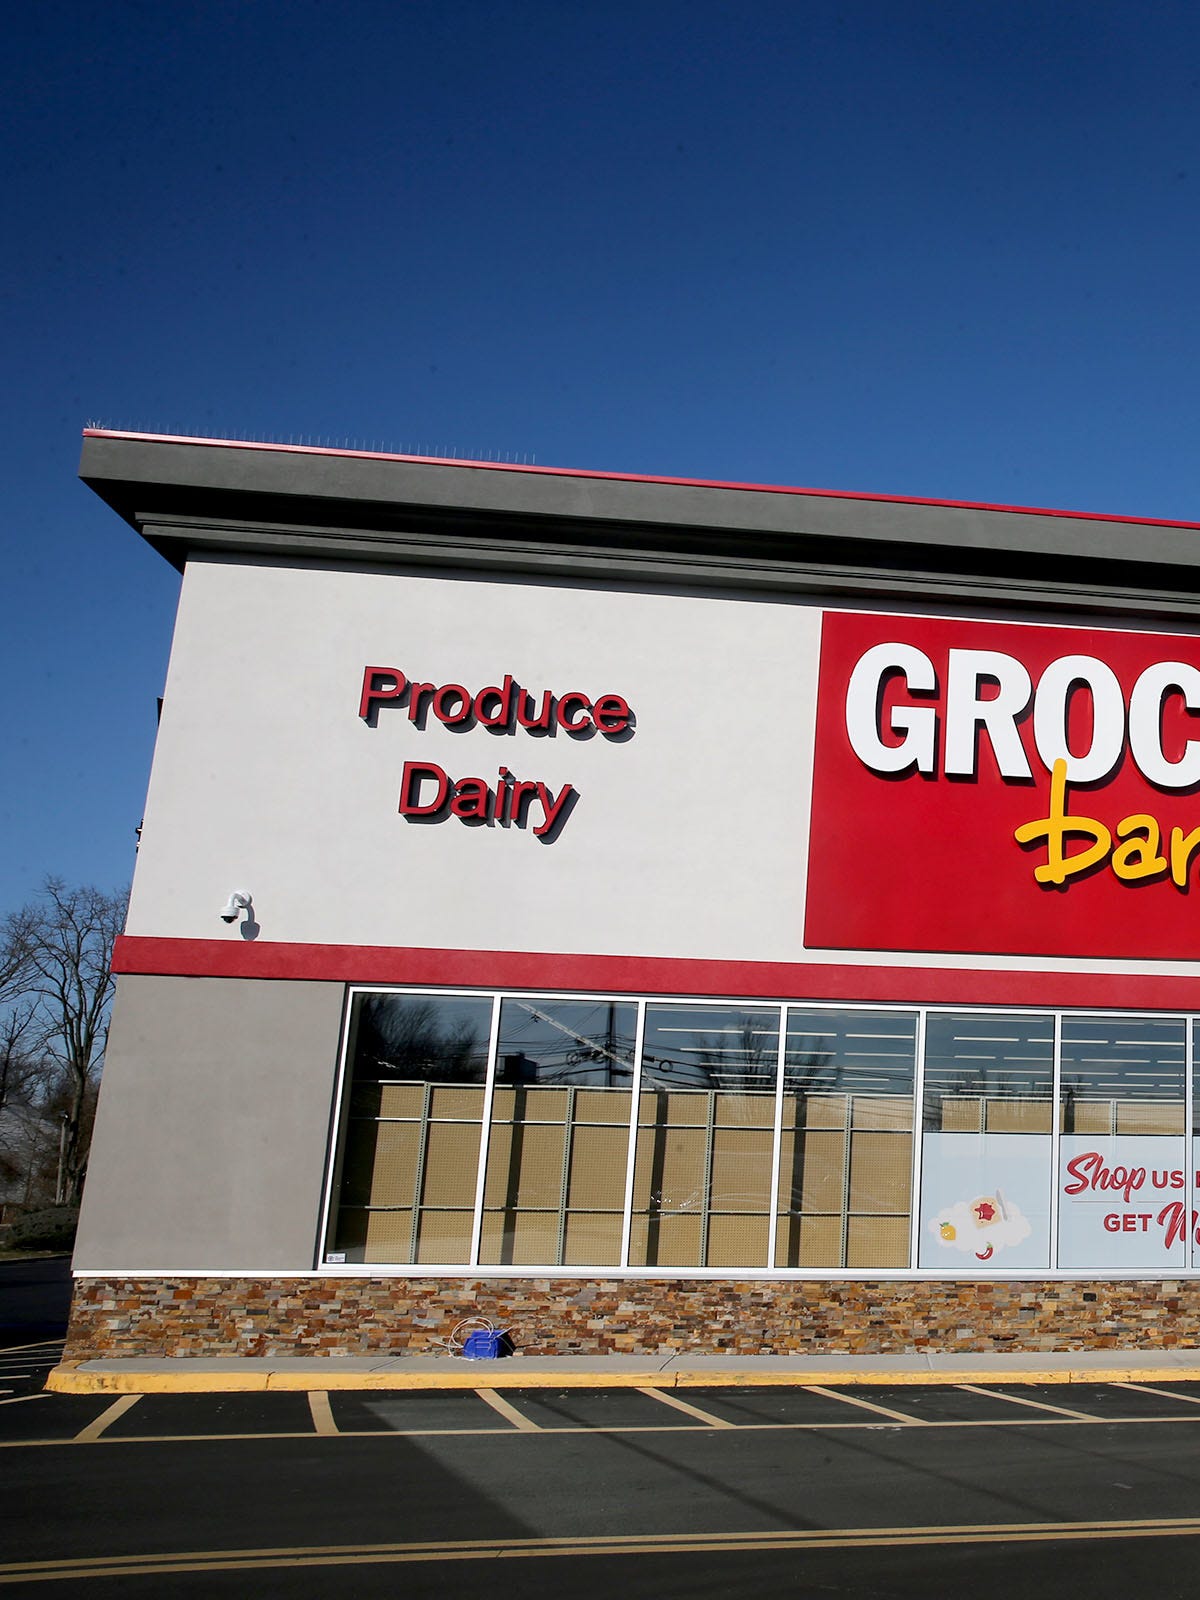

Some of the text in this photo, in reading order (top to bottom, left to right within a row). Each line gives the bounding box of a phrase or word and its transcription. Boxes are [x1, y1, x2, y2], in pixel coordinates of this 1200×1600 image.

[359, 666, 635, 742] Produce
[398, 761, 579, 844] Dairy
[1064, 1152, 1146, 1203] Shop
[1152, 1170, 1184, 1188] US
[1103, 1213, 1152, 1232] GET
